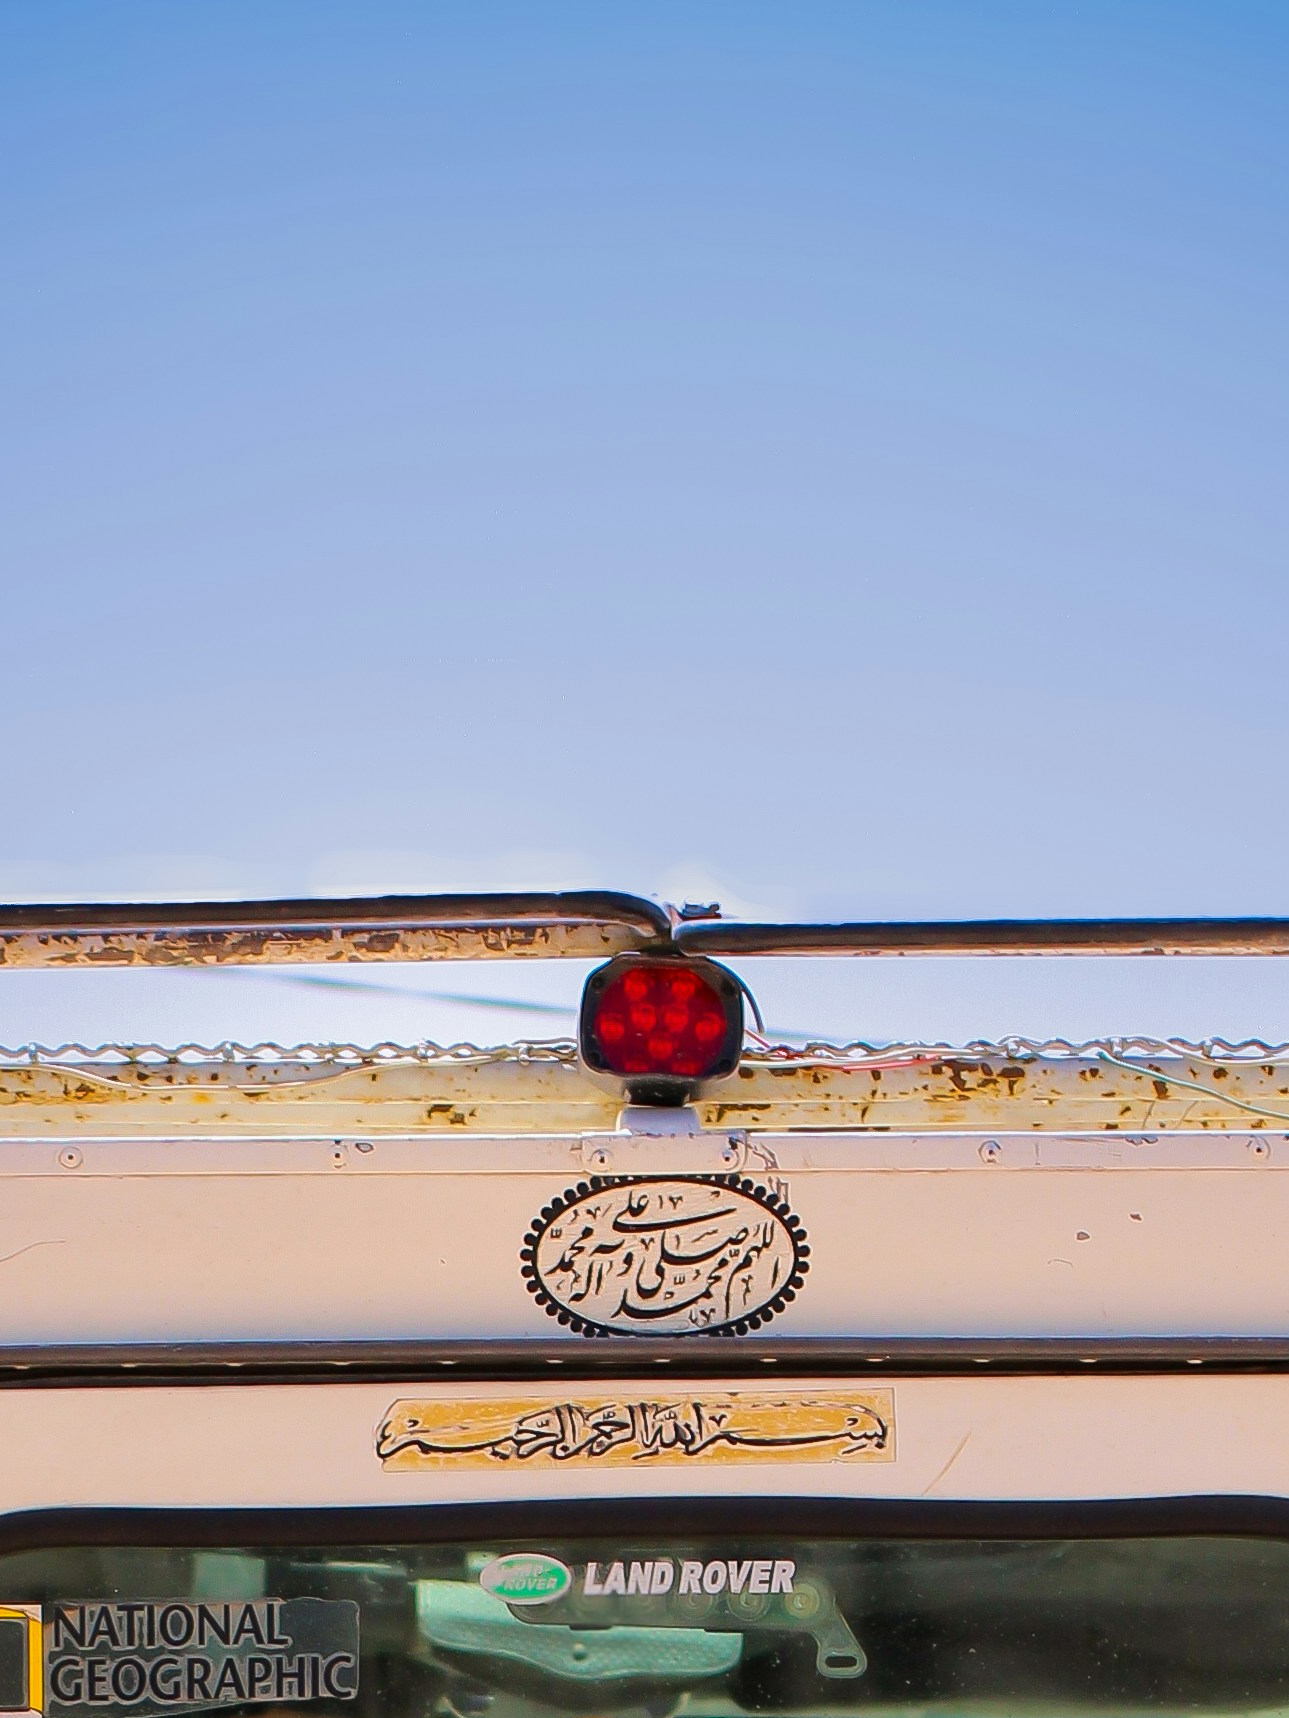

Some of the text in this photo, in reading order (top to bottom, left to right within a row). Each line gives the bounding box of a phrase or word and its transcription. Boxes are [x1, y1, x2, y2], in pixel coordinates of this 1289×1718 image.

[583, 1562, 674, 1595] LAND
[678, 1560, 795, 1595] ROVER
[53, 1603, 290, 1648] NATIONAL
[50, 1654, 356, 1703] GEOGRAPHIC
